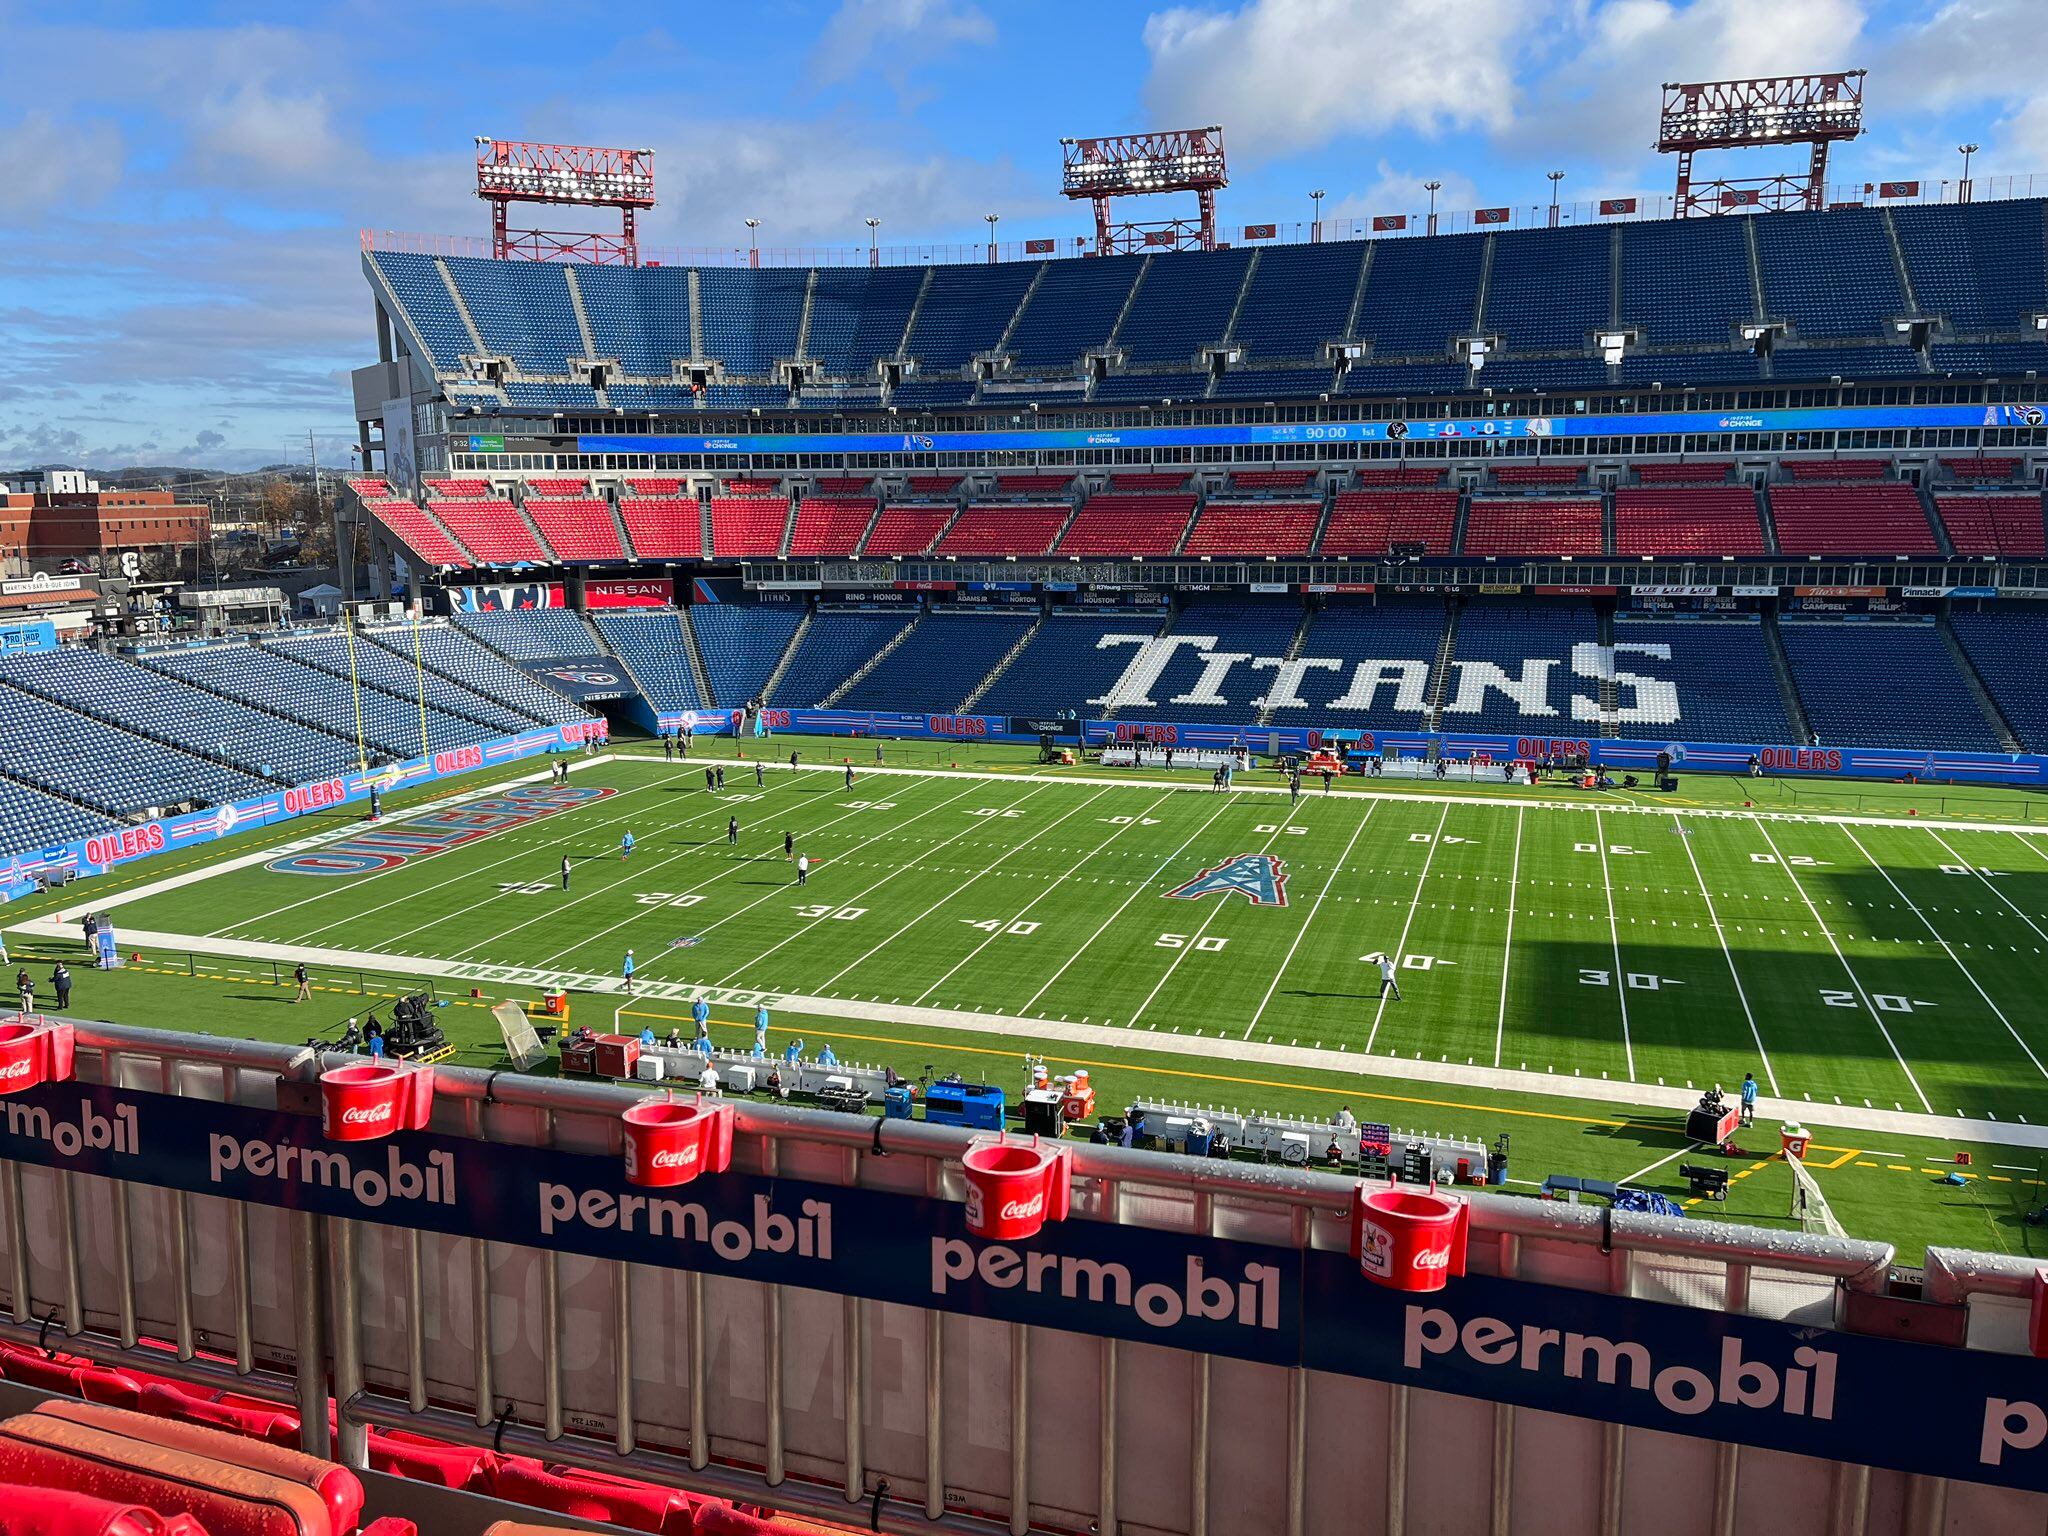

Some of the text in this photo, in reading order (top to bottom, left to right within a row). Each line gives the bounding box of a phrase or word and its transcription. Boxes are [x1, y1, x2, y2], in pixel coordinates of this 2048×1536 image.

[596, 584, 662, 595] NISSAN
[845, 593, 866, 601] RING
[873, 593, 903, 601] HONOR
[1808, 587, 1835, 596] Tito's
[1903, 588, 1941, 597] Pinnacle
[1802, 603, 1847, 611] CAMPBELL
[534, 662, 605, 673] NISSAN
[1086, 634, 1681, 725] TITANS
[584, 692, 621, 701] NISSAN
[929, 715, 988, 737] OILERS
[434, 745, 484, 775] OILERS
[1516, 737, 1592, 760] OILERS
[1759, 746, 1843, 772] OILERS
[283, 777, 347, 815] OILERS
[264, 785, 620, 876] OILERS
[85, 823, 165, 866] OILERS
[636, 892, 708, 907] 20
[796, 905, 870, 921] 30
[972, 919, 1043, 935] 40
[1154, 933, 1231, 952] 50
[448, 963, 602, 989] INSPIRE
[1578, 968, 1661, 991] 30
[1818, 988, 1916, 1013] 20
[342, 1101, 393, 1124] Coca-Cola
[210, 1132, 457, 1207] permobil
[1957, 1153, 1970, 1165] 20
[539, 1181, 833, 1261] permobil
[930, 1235, 1281, 1329] permobil
[1403, 1303, 1839, 1421] permobil
[585, 1419, 606, 1429] WEST
